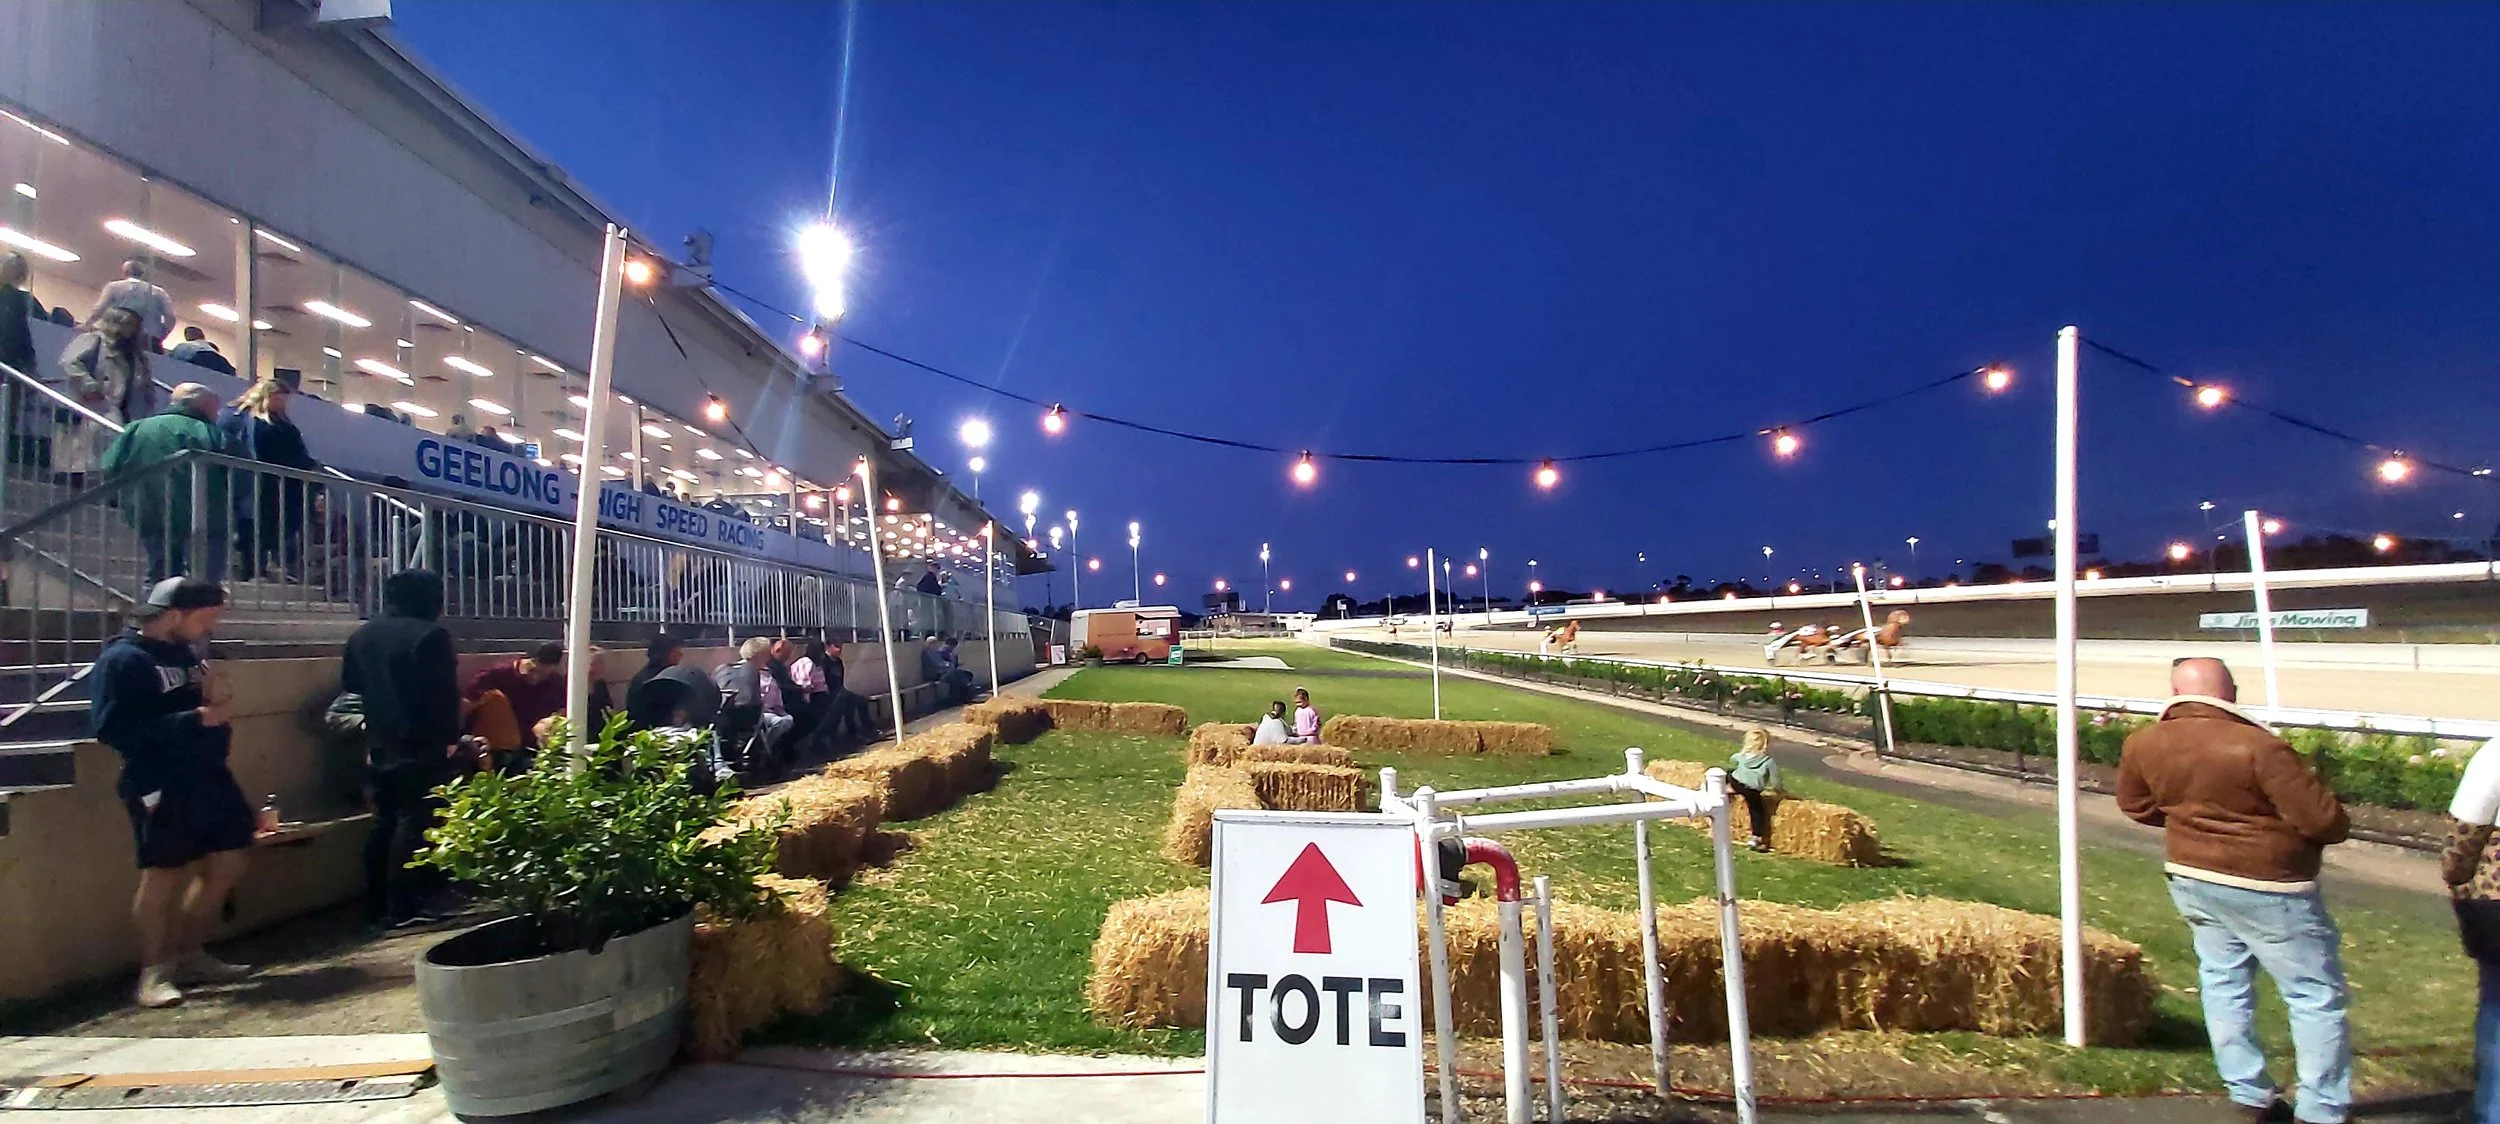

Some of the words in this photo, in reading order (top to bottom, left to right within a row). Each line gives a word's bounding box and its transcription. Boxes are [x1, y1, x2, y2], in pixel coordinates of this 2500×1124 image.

[416, 439, 559, 505] GEELONG
[656, 504, 707, 537] SPEED
[718, 520, 764, 550] RACING
[1227, 973, 1406, 1047] TOTE
